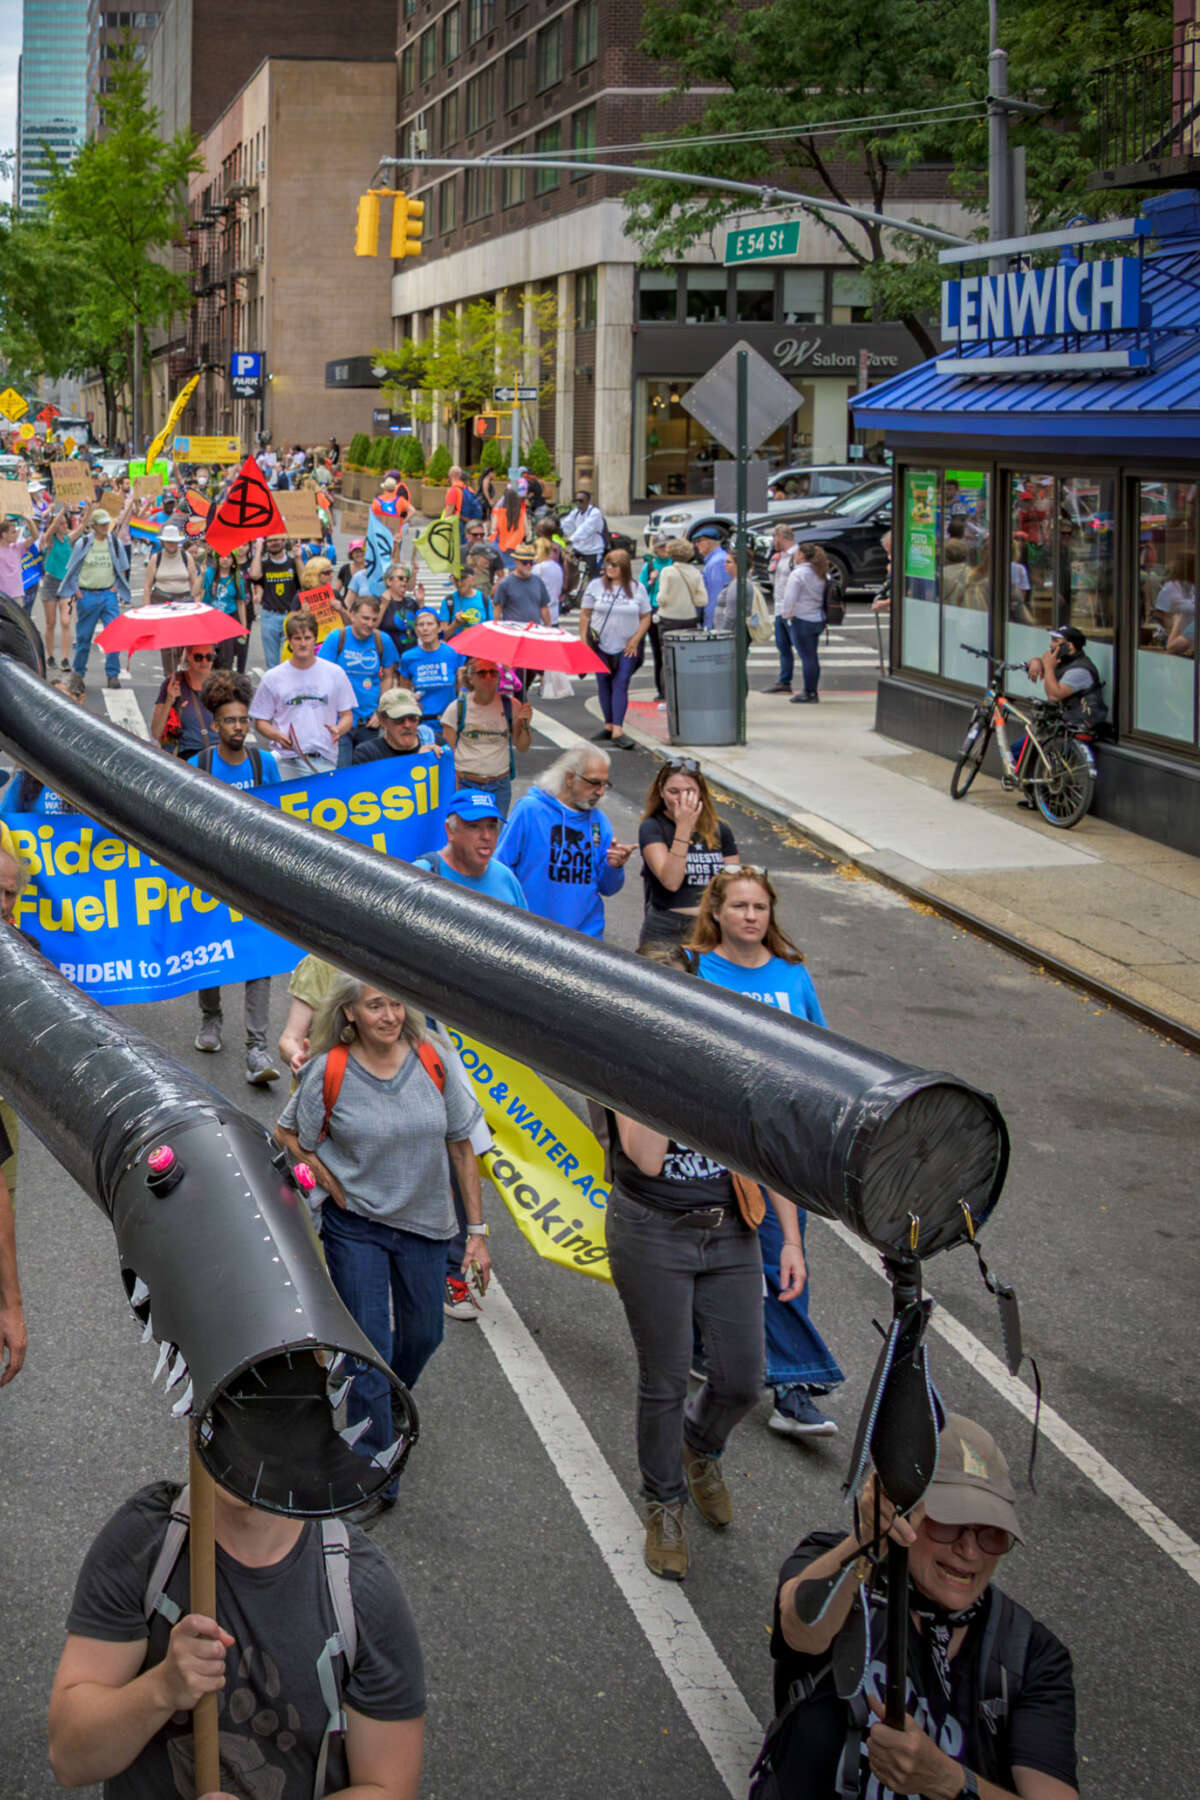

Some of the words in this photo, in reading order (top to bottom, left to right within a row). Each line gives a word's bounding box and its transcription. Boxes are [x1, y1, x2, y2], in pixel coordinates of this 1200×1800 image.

[736, 236, 744, 256] E
[746, 230, 764, 254] 54
[768, 229, 785, 250] St
[941, 257, 1123, 342] LENWICH
[238, 355, 254, 375] P
[773, 337, 821, 367] W
[812, 353, 856, 367] Salon
[280, 765, 440, 832] Fossil
[549, 866, 591, 885] LAKE
[60, 960, 133, 983] BIDEN
[139, 960, 161, 979] to
[166, 939, 235, 977] 23321
[448, 1030, 493, 1084] OOD
[489, 1082, 509, 1104] &
[506, 1096, 580, 1178] WATER
[572, 1175, 610, 1210] AC
[482, 1144, 610, 1267] racking
